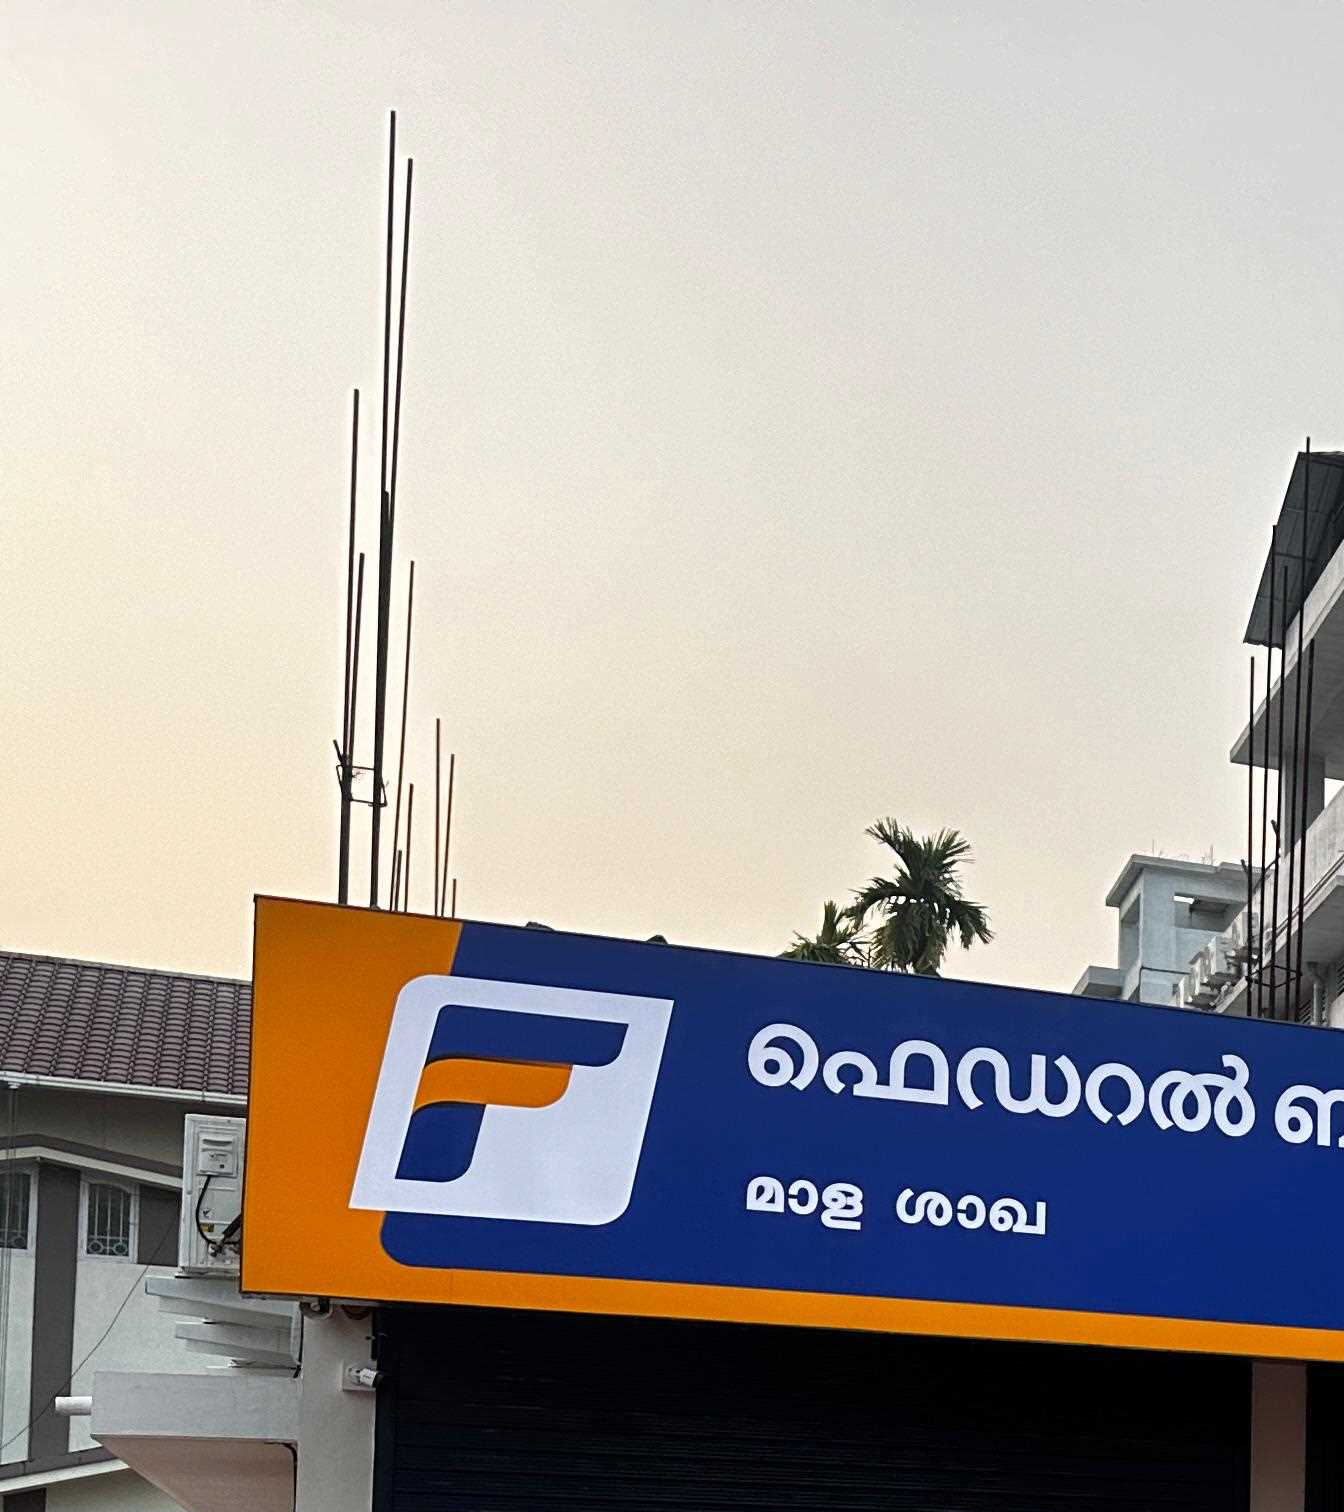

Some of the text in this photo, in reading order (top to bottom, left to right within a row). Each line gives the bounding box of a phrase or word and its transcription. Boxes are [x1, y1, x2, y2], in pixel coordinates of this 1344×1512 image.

[747, 1022, 1256, 1137] ഫെഡറൽ
[746, 1176, 1046, 1236] മാള ശാഖ
